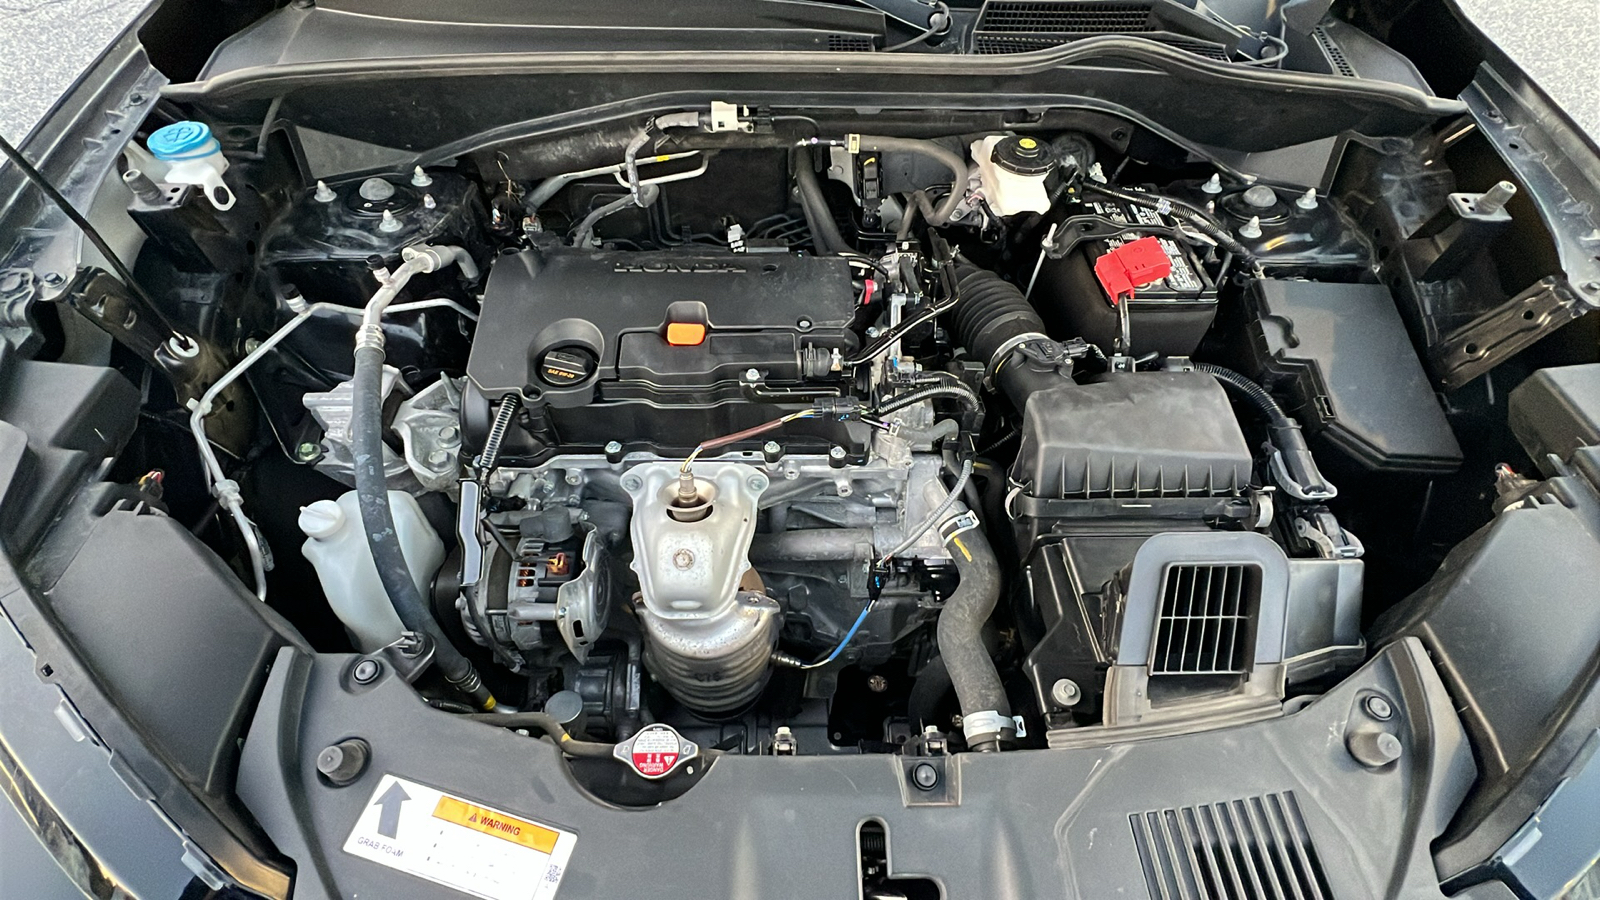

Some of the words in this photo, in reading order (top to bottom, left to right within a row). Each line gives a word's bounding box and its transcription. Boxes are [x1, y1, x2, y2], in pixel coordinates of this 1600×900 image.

[614, 261, 747, 273] HONDA
[480, 816, 521, 836] WARNING
[357, 836, 380, 850] GRAB
